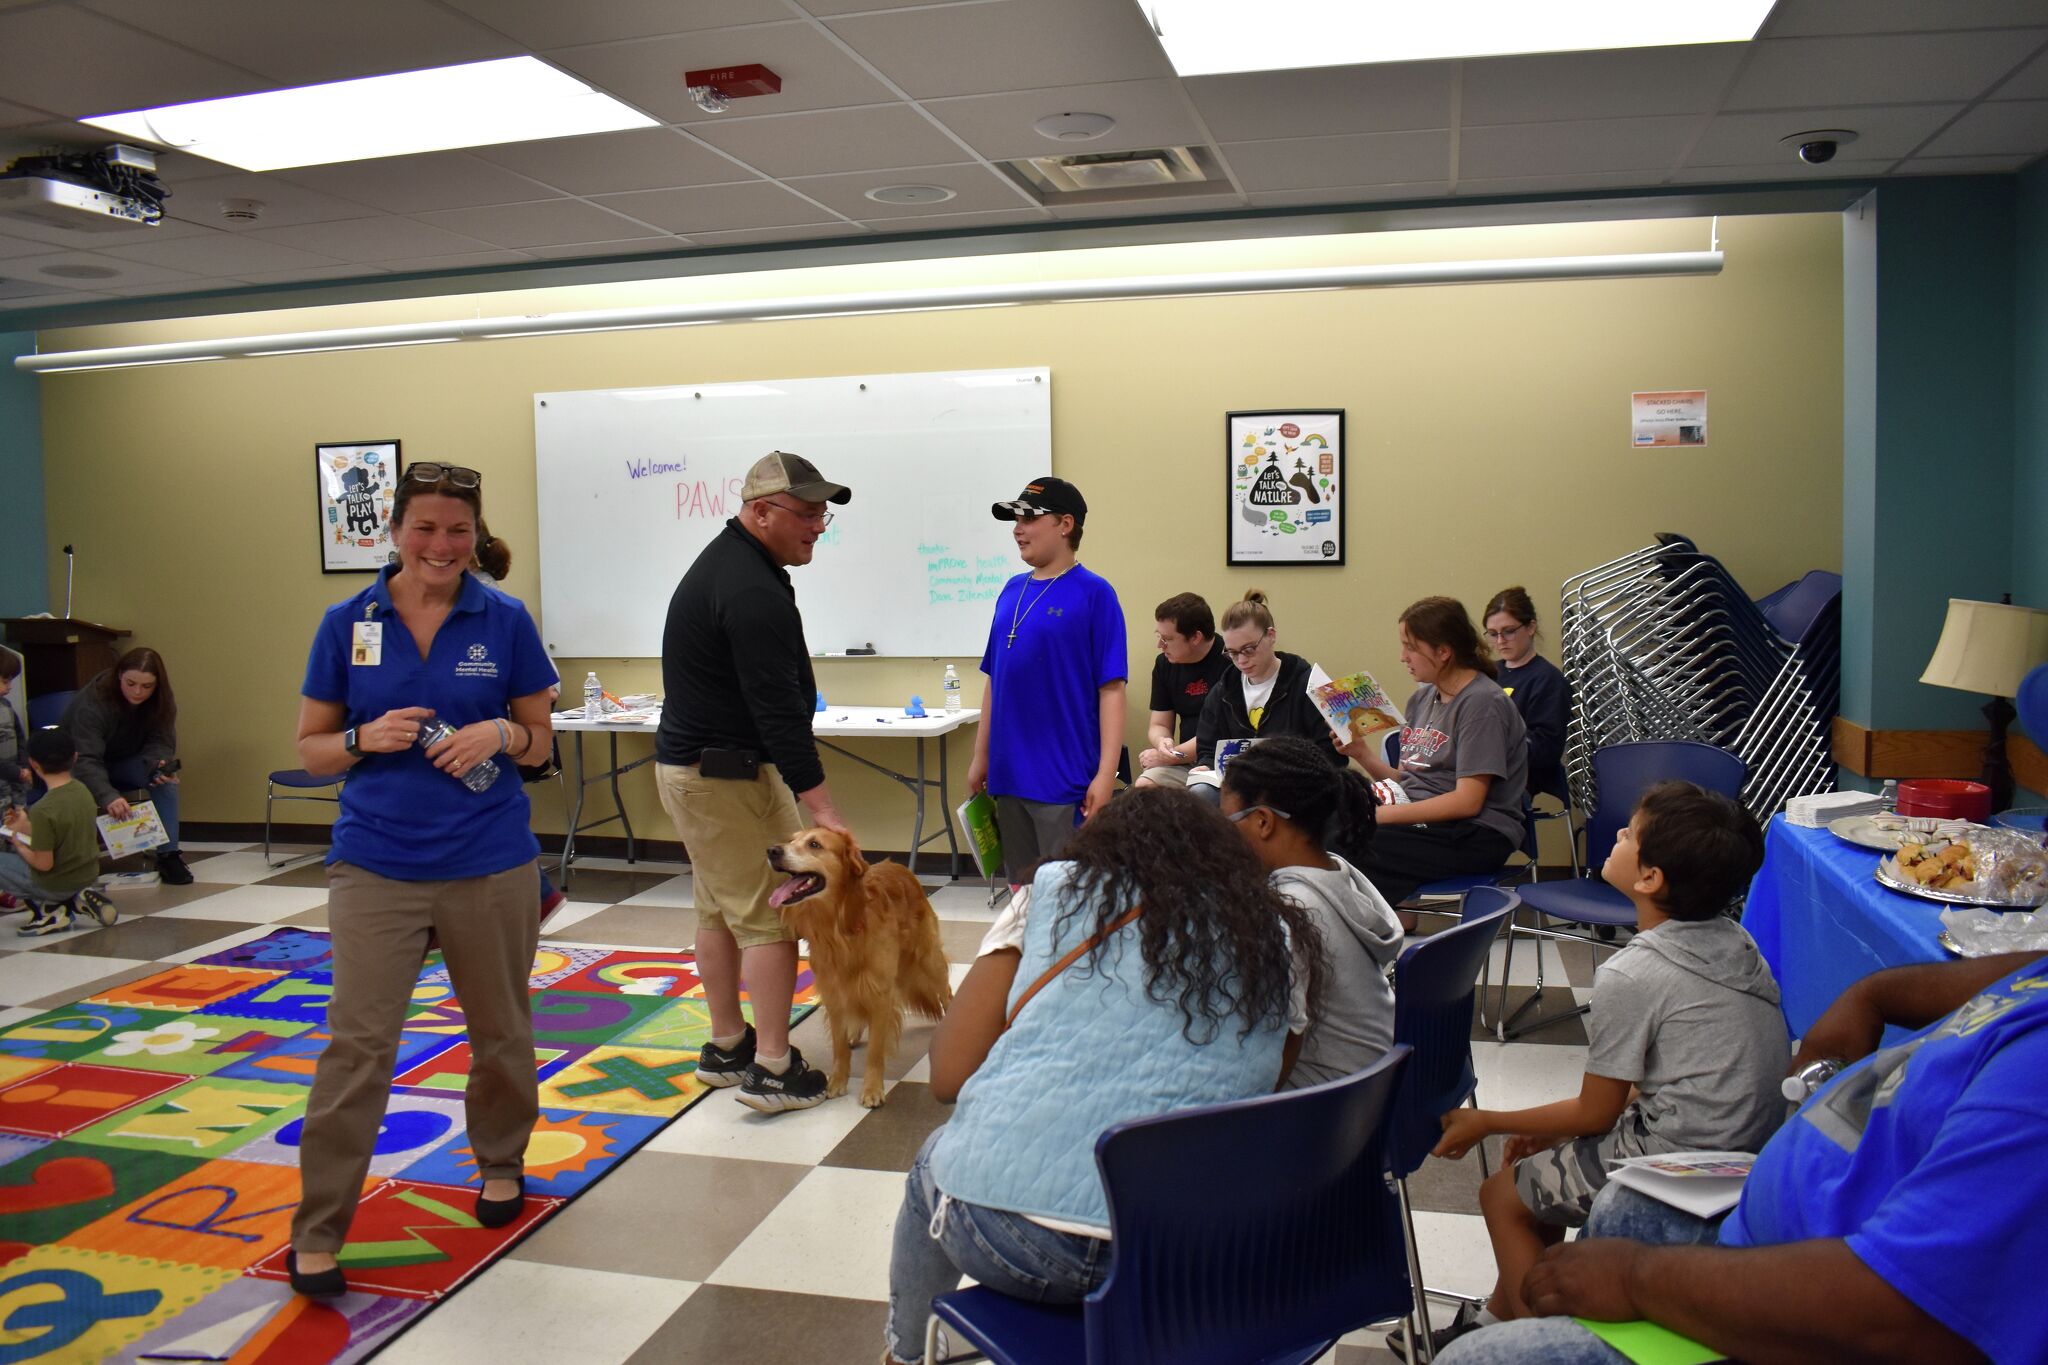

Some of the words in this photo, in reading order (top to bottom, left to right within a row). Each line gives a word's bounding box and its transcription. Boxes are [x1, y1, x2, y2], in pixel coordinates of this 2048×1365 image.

[710, 71, 735, 81] FIRE
[626, 454, 687, 480] Welcome!
[1259, 480, 1276, 490] TALK
[347, 492, 364, 504] TALK
[350, 502, 372, 518] PLAY
[457, 661, 497, 669] Community
[761, 1077, 785, 1090] HOKA
